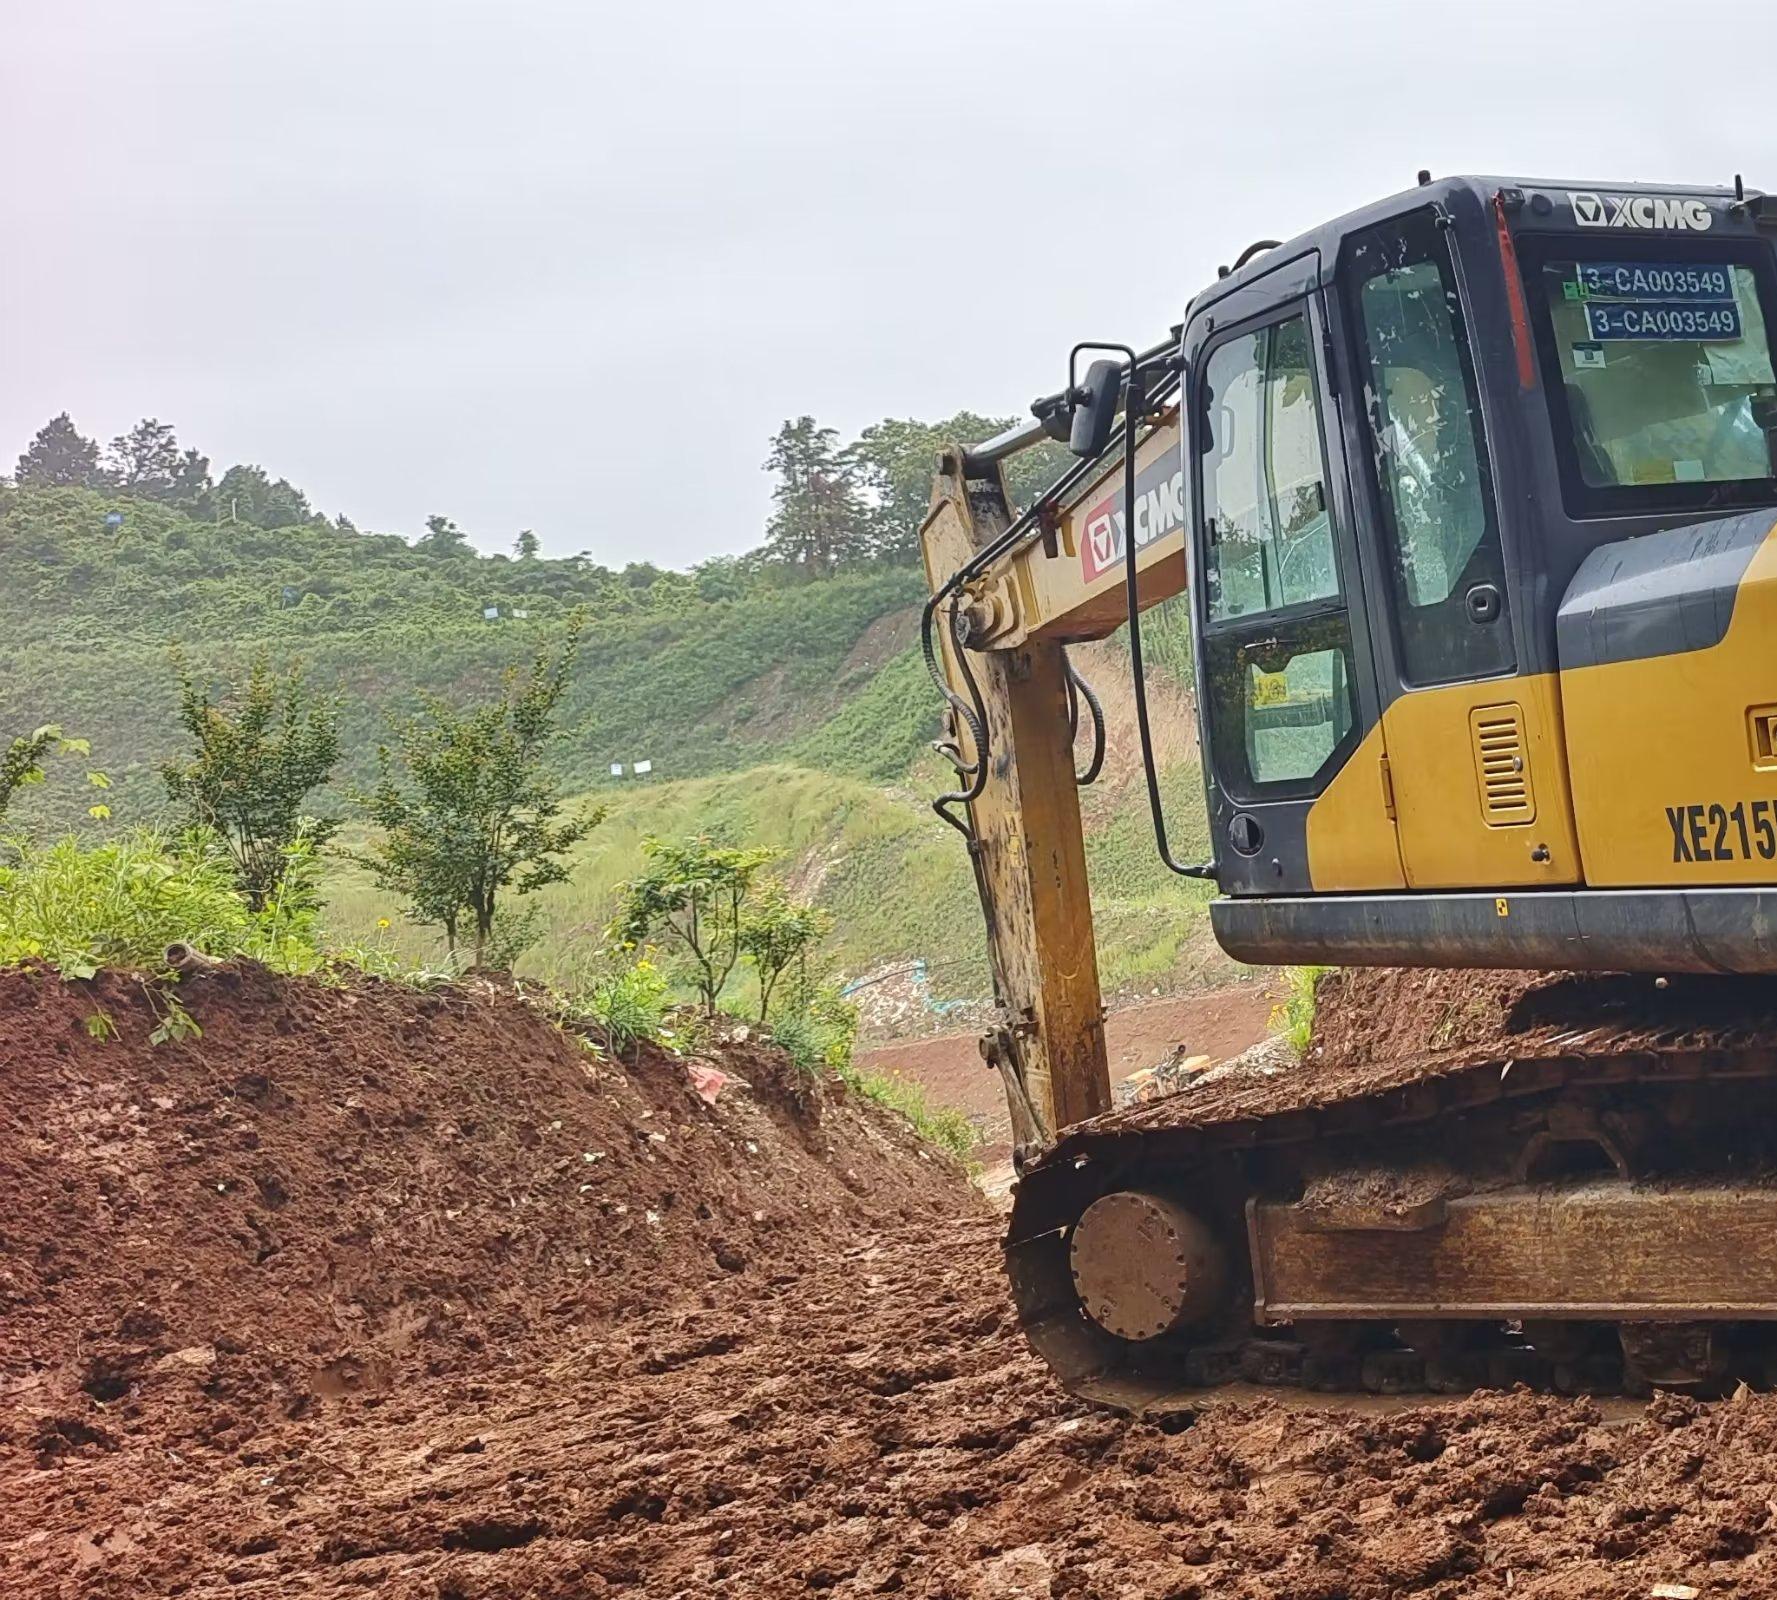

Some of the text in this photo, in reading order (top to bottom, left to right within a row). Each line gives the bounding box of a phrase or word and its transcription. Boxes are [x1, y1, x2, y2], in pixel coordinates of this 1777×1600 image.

[1605, 197, 1712, 231] XCMG
[1586, 268, 1726, 293] 3-CA003549
[1595, 310, 1735, 333] 3-CA003549
